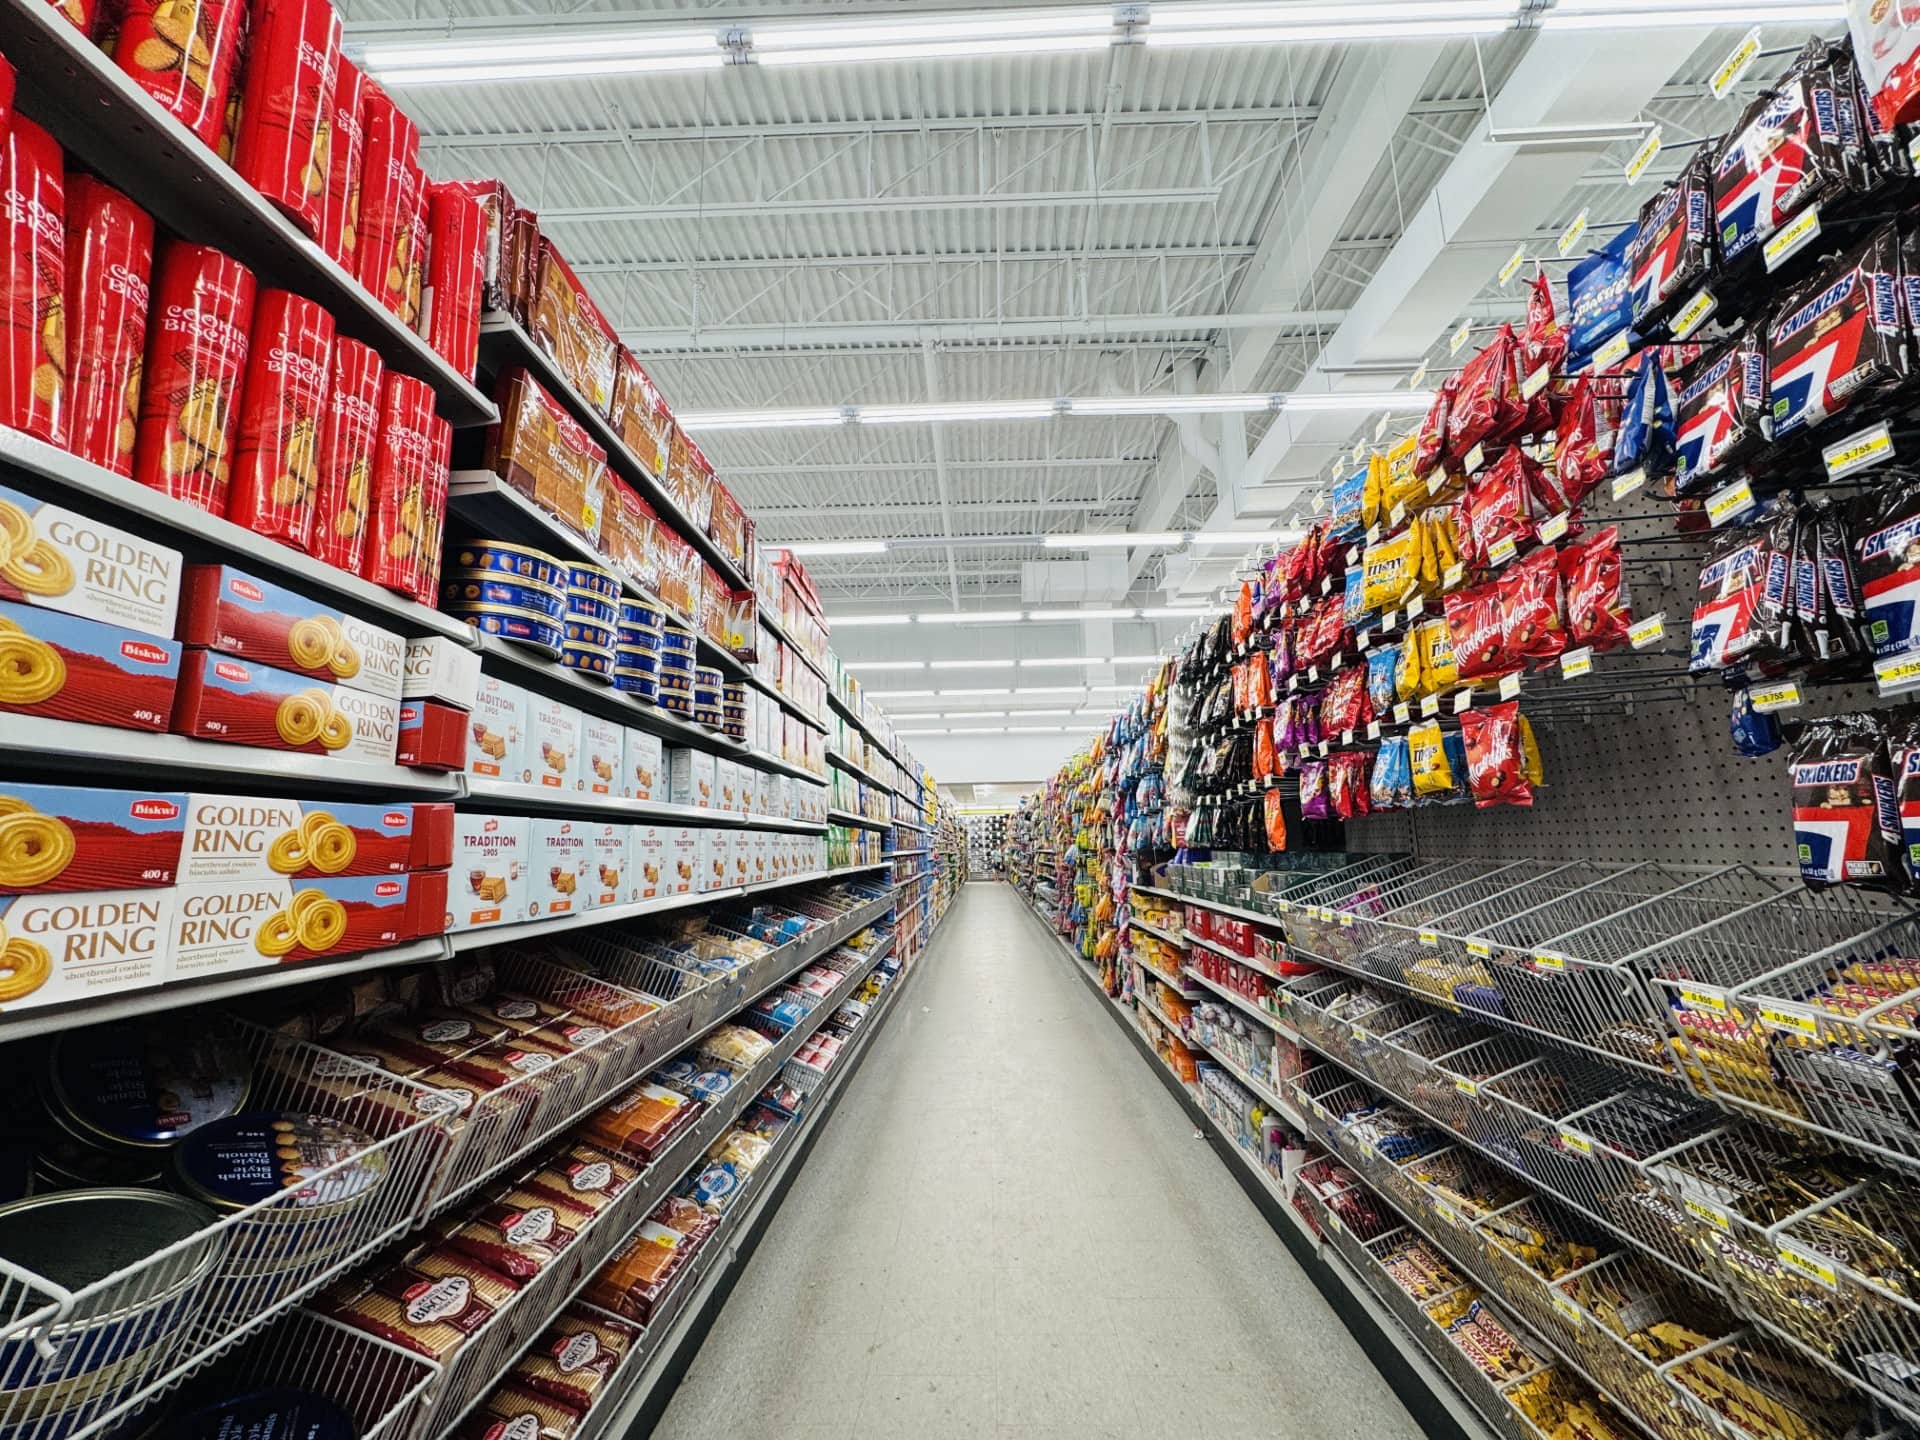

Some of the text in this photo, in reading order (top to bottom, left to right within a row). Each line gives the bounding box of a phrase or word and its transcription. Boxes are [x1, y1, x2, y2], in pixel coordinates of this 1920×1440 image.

[1814, 90, 1836, 134] SNICKERS
[1780, 273, 1854, 342] SNICKERS
[1875, 274, 1896, 324] SNICKERS
[1682, 353, 1731, 405] SNICKERS
[1744, 354, 1763, 398] SNICKERS
[547, 441, 585, 483] Biscuits
[49, 521, 170, 580] GOLDEN
[85, 558, 166, 605] RING
[1768, 553, 1787, 600] SNICKERS
[1796, 561, 1815, 609] SNICKERS
[1826, 558, 1851, 607] SNICKERS
[232, 581, 263, 600] Biskwi
[123, 643, 166, 662] Biskwi
[348, 625, 400, 658] GOLDEN
[218, 665, 249, 681] Biskwi
[364, 650, 399, 677] RING
[133, 709, 152, 721] 400
[340, 696, 395, 723] GOLDEN
[538, 711, 573, 731] TRADITION
[205, 721, 221, 731] 400
[356, 717, 394, 742] RING
[1798, 762, 1858, 784] SNICKERS
[134, 804, 176, 816] Biskwi
[196, 804, 293, 828] GOLDEN
[1875, 776, 1900, 831] SNICKERS
[192, 828, 265, 853] RING
[464, 836, 516, 848] TRADITION
[482, 848, 498, 857] 1905
[546, 837, 584, 848] TRADITION
[595, 838, 623, 848] TRADITION
[141, 869, 169, 881] 400 g
[22, 900, 160, 934] GOLDEN
[184, 892, 283, 918] GOLDEN
[179, 916, 251, 946] RING
[63, 926, 156, 962] RING
[217, 1151, 270, 1159] Danois
[231, 1157, 271, 1165] Style
[217, 1172, 273, 1182] Danish
[233, 1165, 272, 1173] Style
[410, 1279, 466, 1320] BISCUITS
